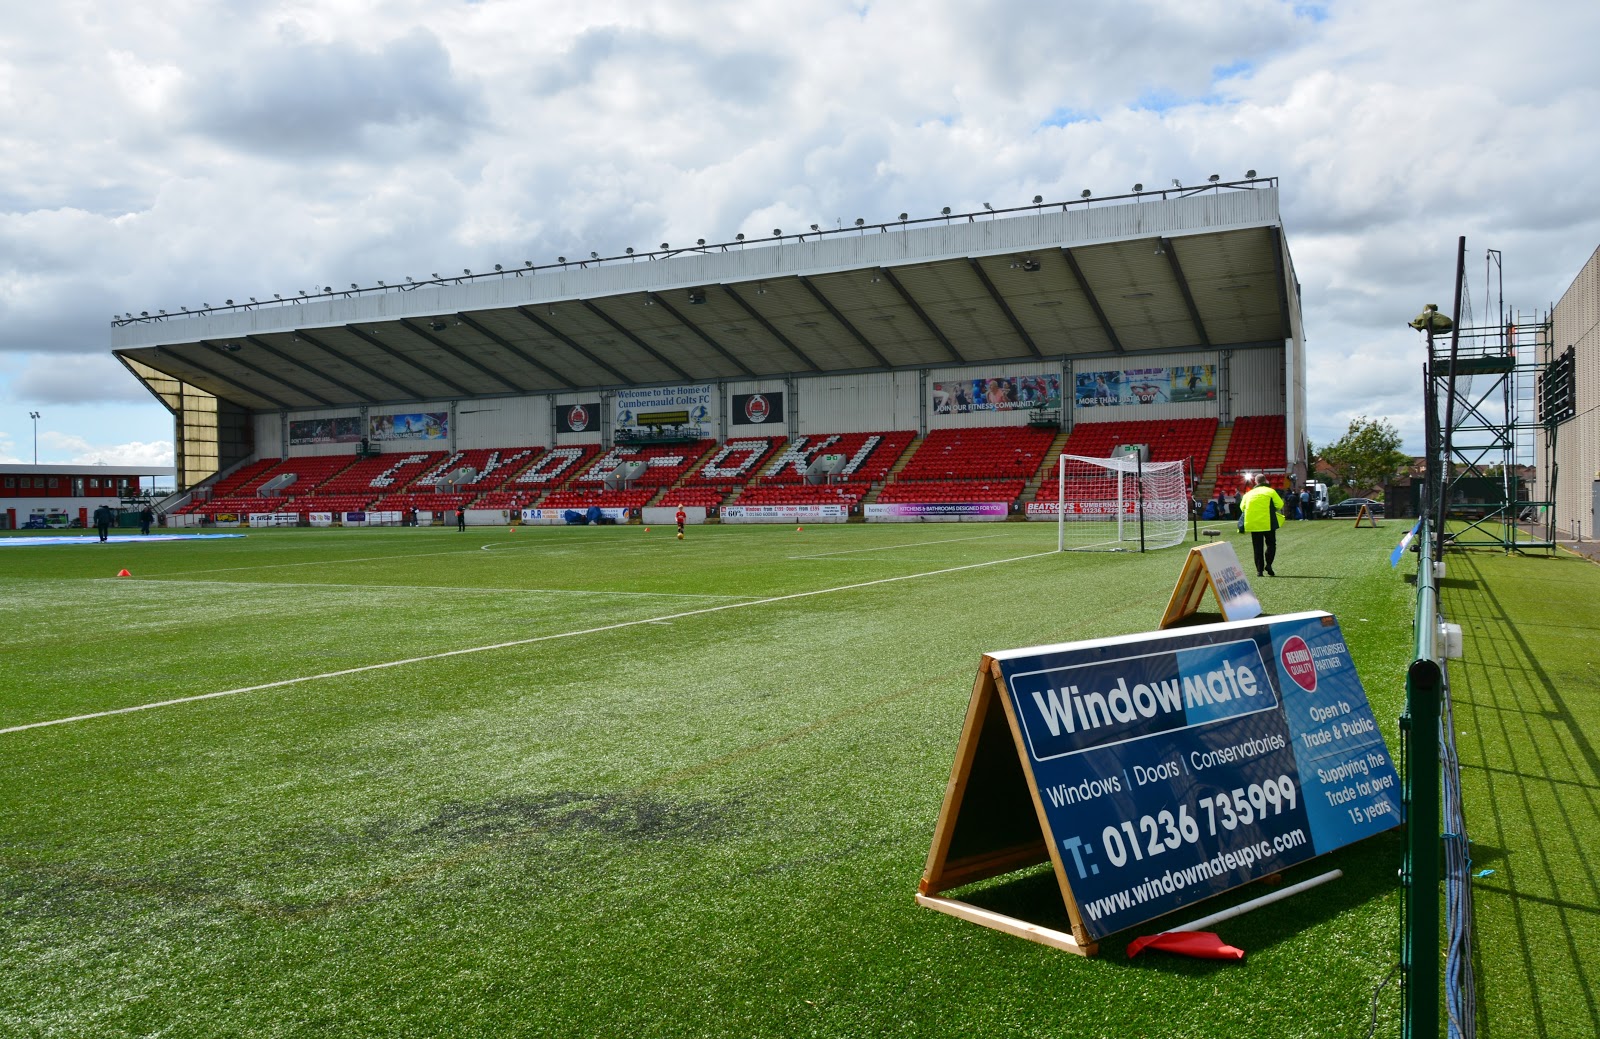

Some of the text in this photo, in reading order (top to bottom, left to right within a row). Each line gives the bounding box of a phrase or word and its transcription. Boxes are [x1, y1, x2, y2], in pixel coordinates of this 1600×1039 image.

[617, 390, 652, 399] Welcome
[663, 388, 676, 396] the
[677, 386, 700, 395] Home
[701, 385, 711, 393] of
[618, 395, 710, 409] Cumbernauld Colts FC
[1079, 397, 1098, 405] MORE
[968, 402, 993, 410] FITNESS
[994, 400, 1035, 409] COMMUNITY
[1285, 649, 1310, 665] REHAU
[1311, 642, 1345, 659] AUTHORISED
[1290, 662, 1313, 676] QUALITY
[1315, 656, 1342, 671] PARTNER
[1032, 659, 1258, 737] Windowmate
[1309, 700, 1351, 723] Open to
[1301, 717, 1374, 748] Trade & Public
[1046, 733, 1286, 809] Windows Doors Conservatories
[1317, 753, 1385, 785] Supplying the
[1325, 774, 1394, 807] Trade for over
[1348, 800, 1391, 825] 15 years
[1063, 774, 1297, 879] T: 01236 735999
[1084, 828, 1307, 921] www.windowmateupvc.com
